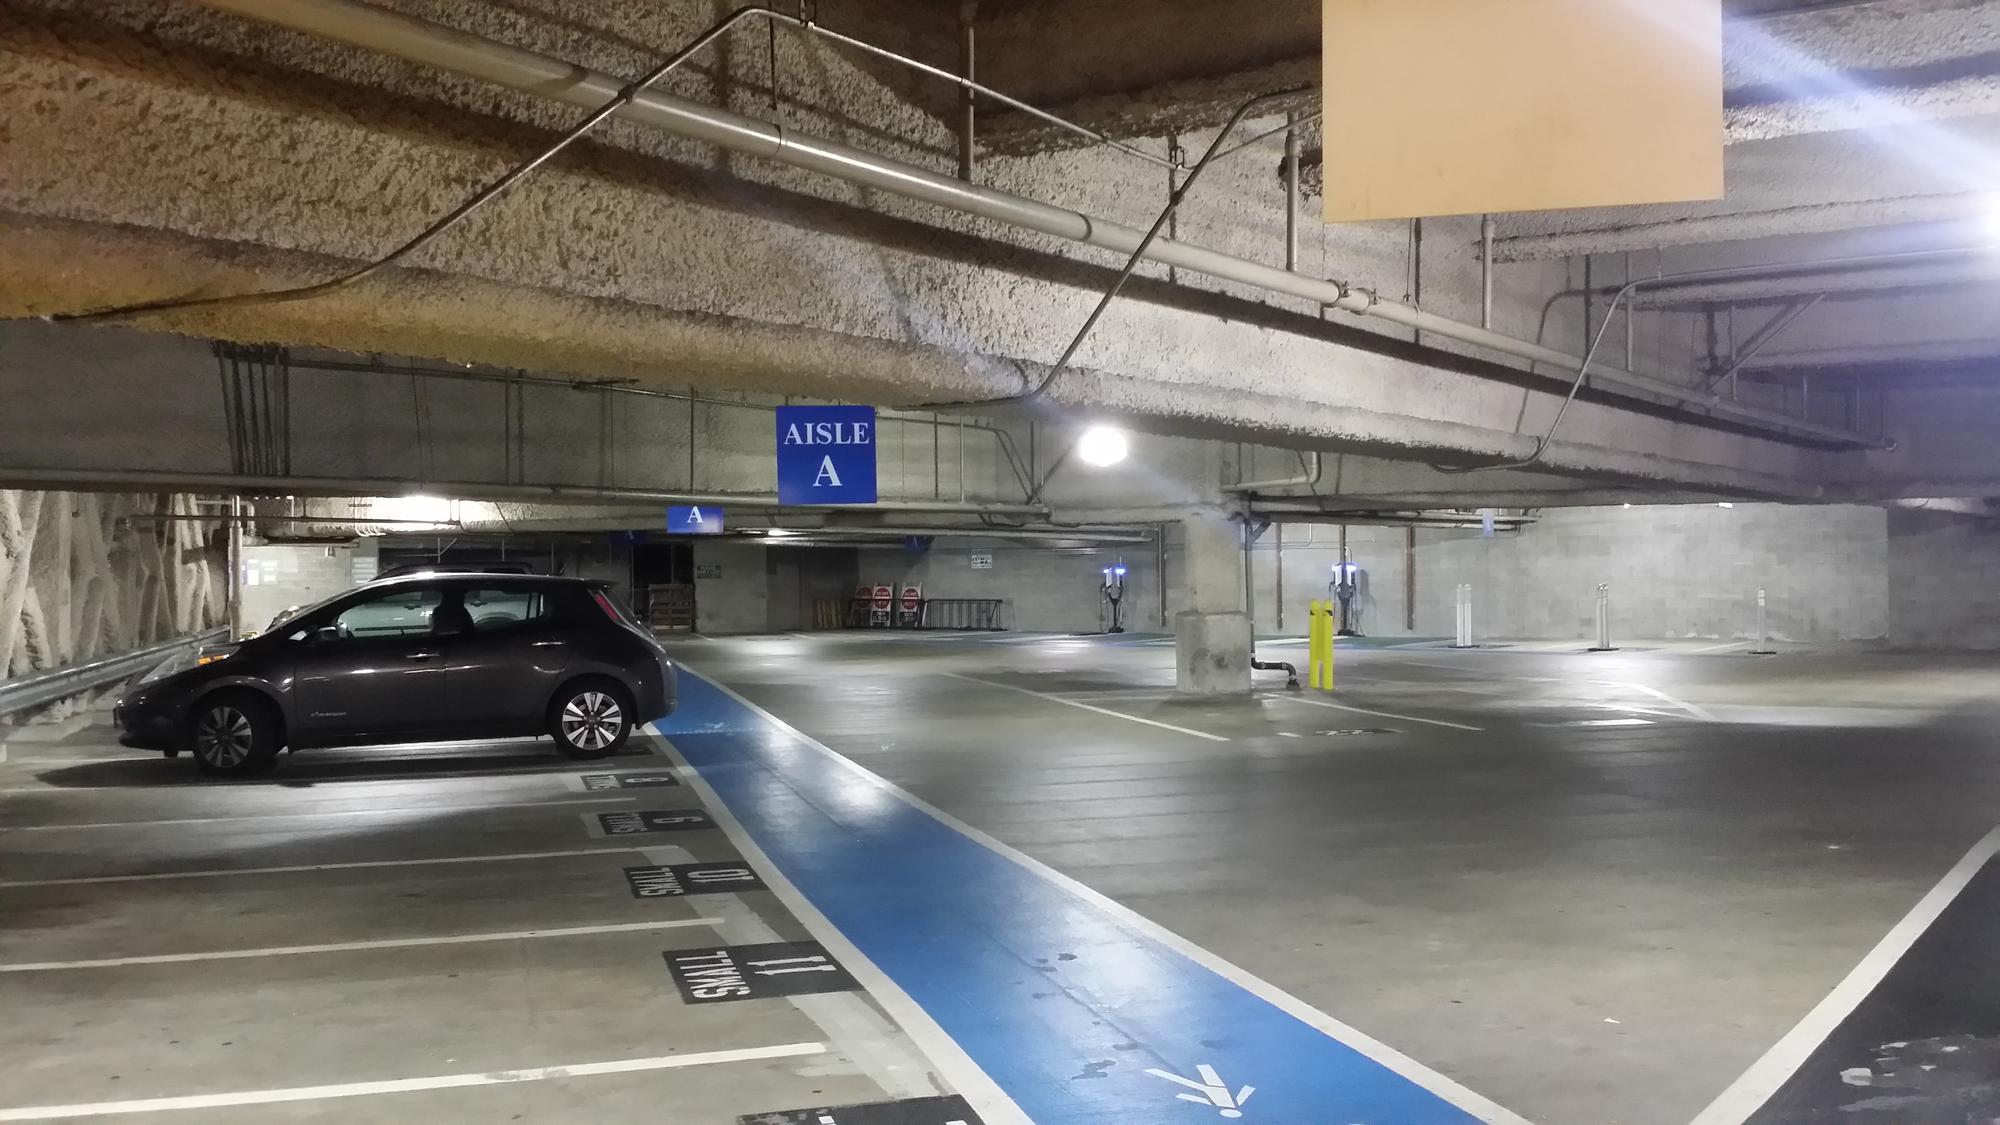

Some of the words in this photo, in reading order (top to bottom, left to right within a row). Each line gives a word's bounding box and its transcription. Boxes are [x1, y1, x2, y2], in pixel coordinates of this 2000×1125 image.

[784, 422, 870, 445] AISLE
[812, 454, 843, 487] A
[686, 505, 704, 524] A
[652, 816, 704, 825] 9
[629, 866, 685, 897] SMALL
[687, 867, 755, 884] 10
[675, 950, 752, 1000] SMALL
[746, 955, 837, 976] 11
